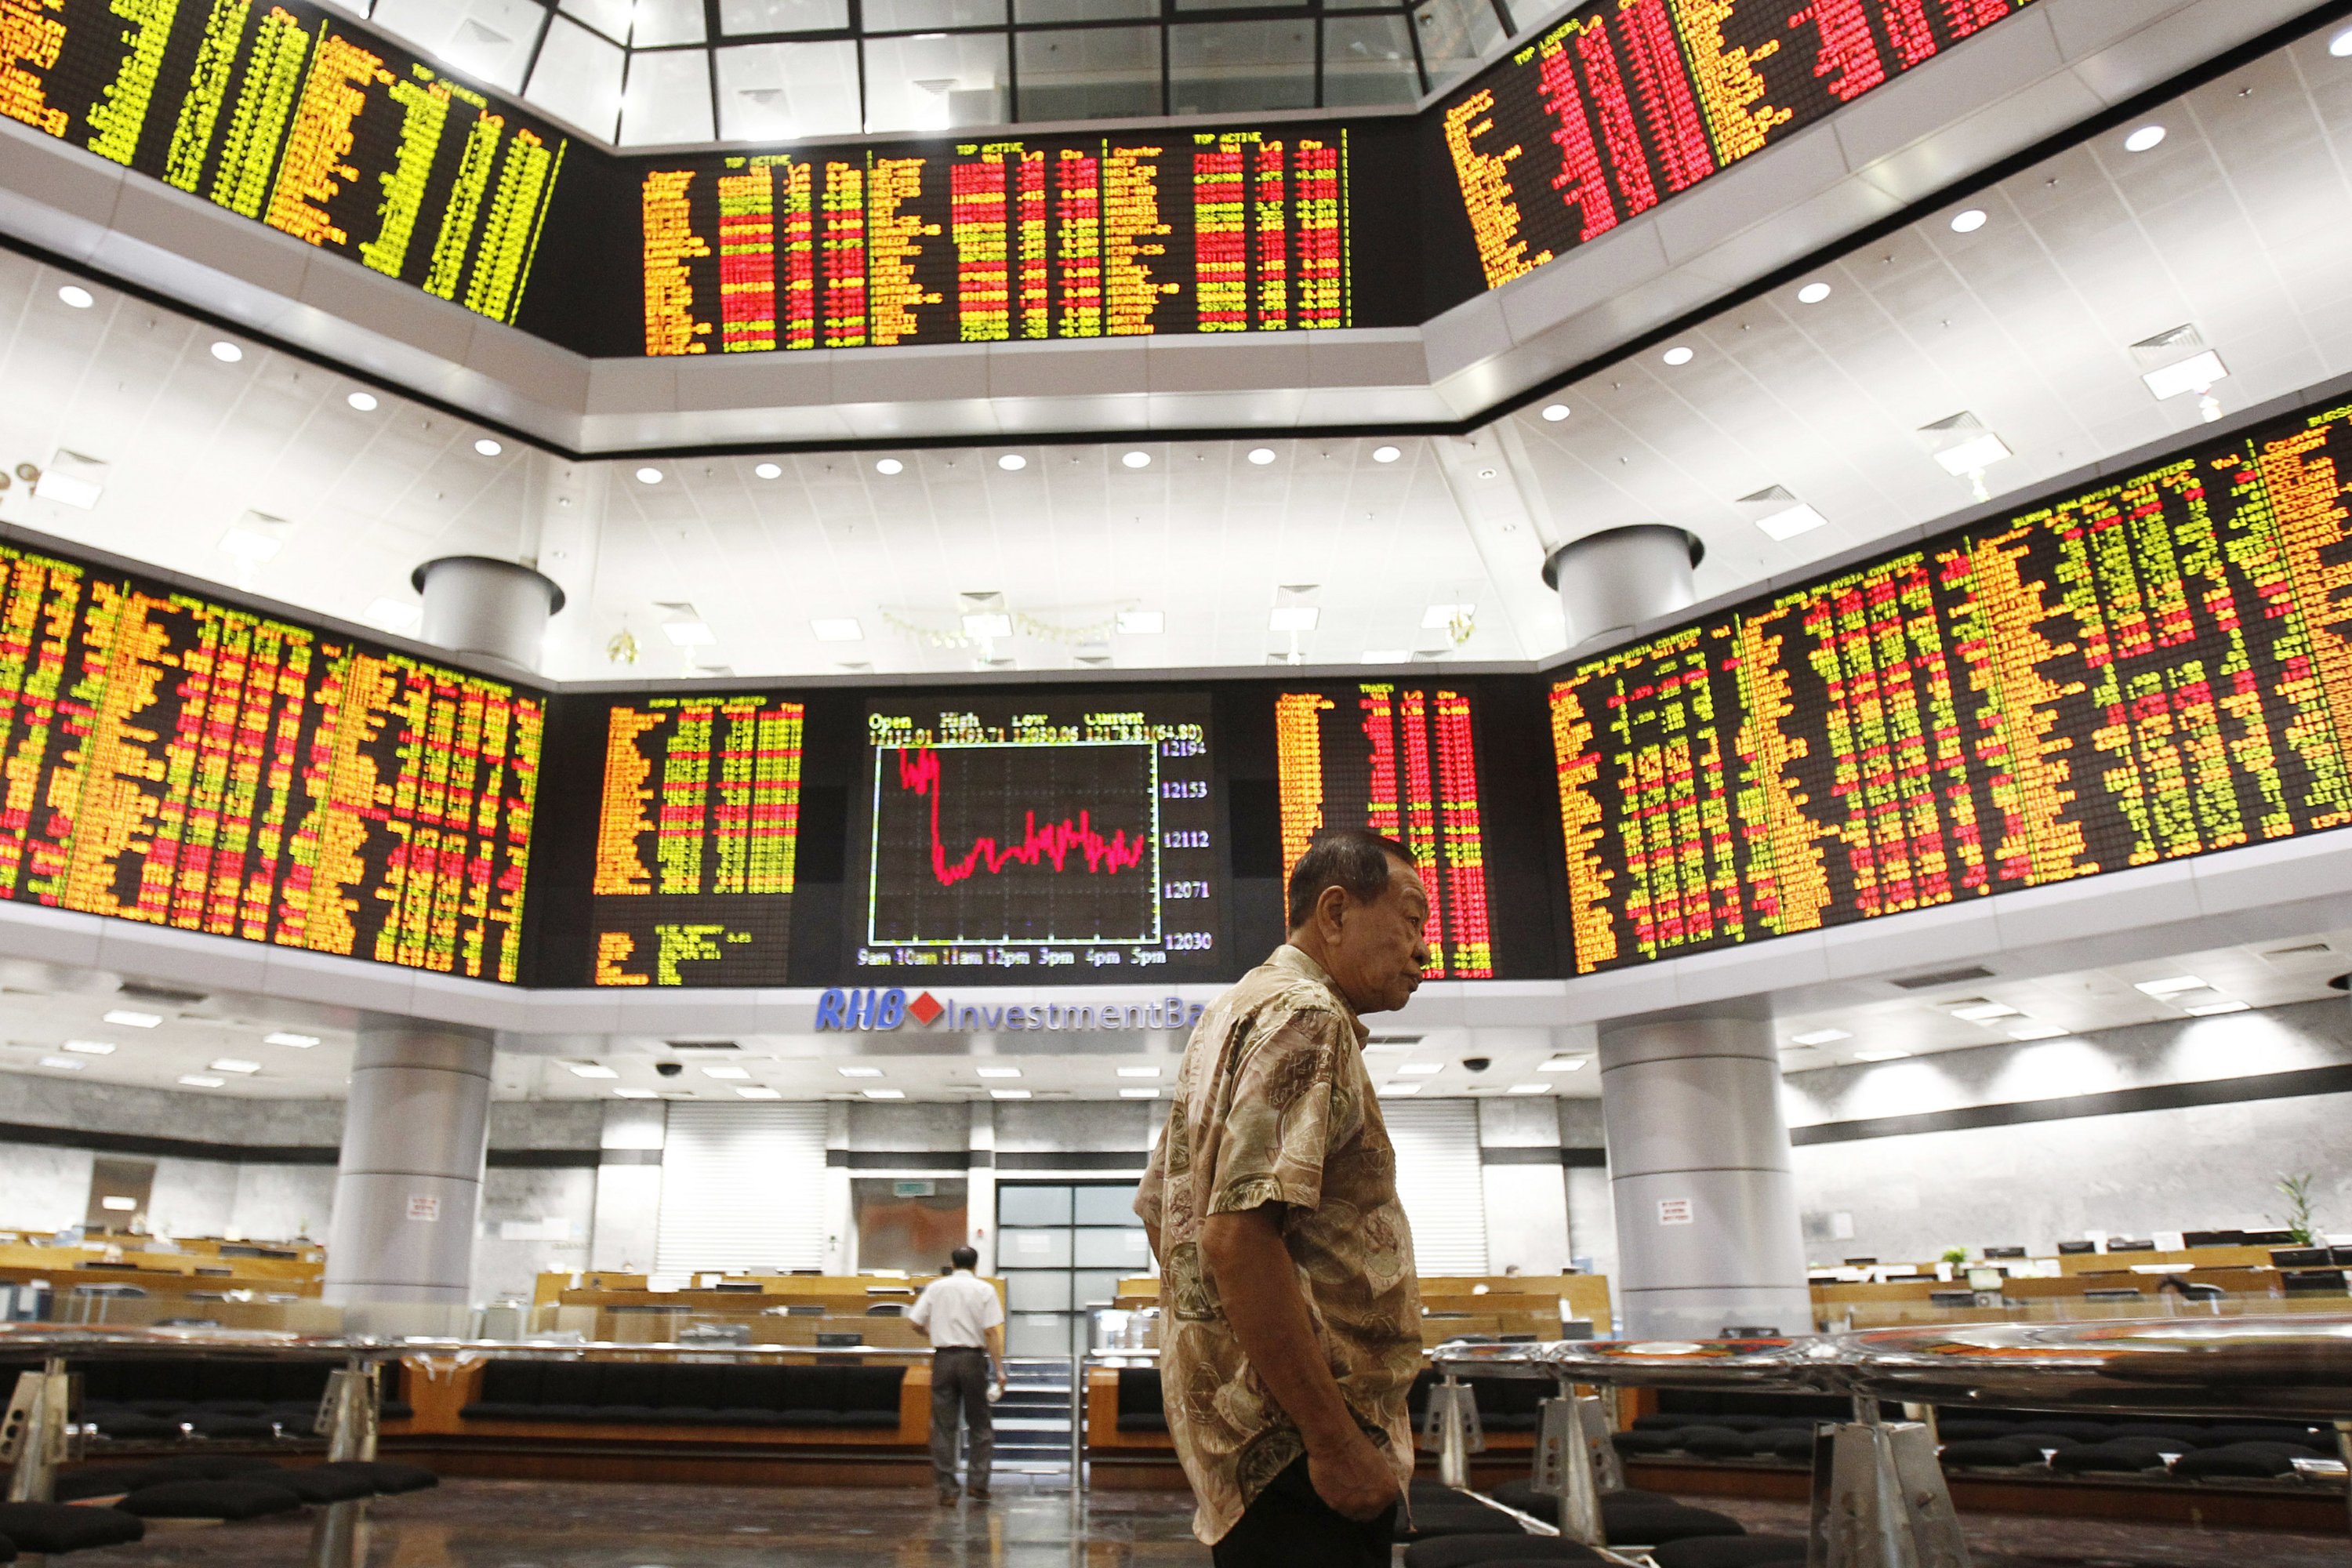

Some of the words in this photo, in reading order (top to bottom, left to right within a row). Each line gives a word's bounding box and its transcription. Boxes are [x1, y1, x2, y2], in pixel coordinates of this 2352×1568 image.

[1514, 46, 1535, 66] TOP
[1538, 18, 1581, 50] LOSERS
[1192, 133, 1215, 145] TOP
[1219, 132, 1261, 143] ACTIVE
[2264, 425, 2333, 453] Counter
[2258, 436, 2327, 466] PARAGON
[2210, 453, 2241, 471] Vol
[2055, 485, 2121, 513] MALAYSIA
[2125, 459, 2196, 488] COUNTERS
[2285, 527, 2352, 556] POHUAT-
[1867, 552, 1924, 577] COUNTERS
[869, 713, 913, 730] Open
[1083, 712, 1145, 725] Current
[1162, 781, 1208, 799] 12153
[1163, 830, 1210, 848] 12112
[1163, 880, 1210, 899] 12071
[1165, 932, 1213, 950] 12030
[857, 947, 892, 965] 9am
[895, 946, 938, 965] 10am
[942, 947, 983, 965] 11am
[1038, 947, 1076, 967] 3pm
[1084, 947, 1121, 967] 4pm
[1130, 947, 1167, 967] 5pm
[815, 987, 906, 1031] RHB
